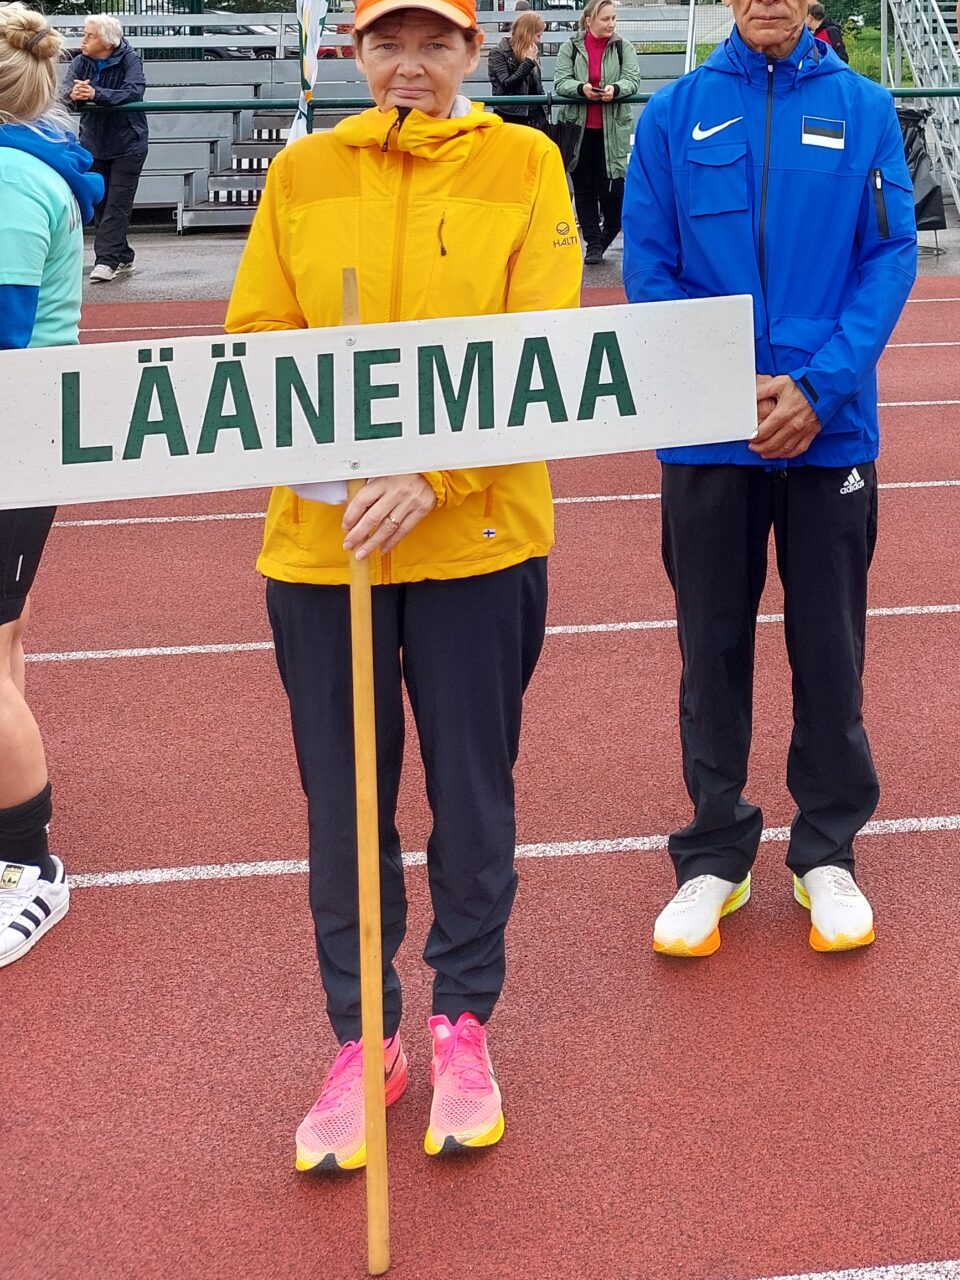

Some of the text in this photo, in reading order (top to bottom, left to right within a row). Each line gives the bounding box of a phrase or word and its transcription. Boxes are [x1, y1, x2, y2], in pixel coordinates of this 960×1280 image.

[553, 236, 578, 248] HALTI
[62, 331, 637, 465] LÄÄNEMAA
[840, 479, 865, 494] adidas
